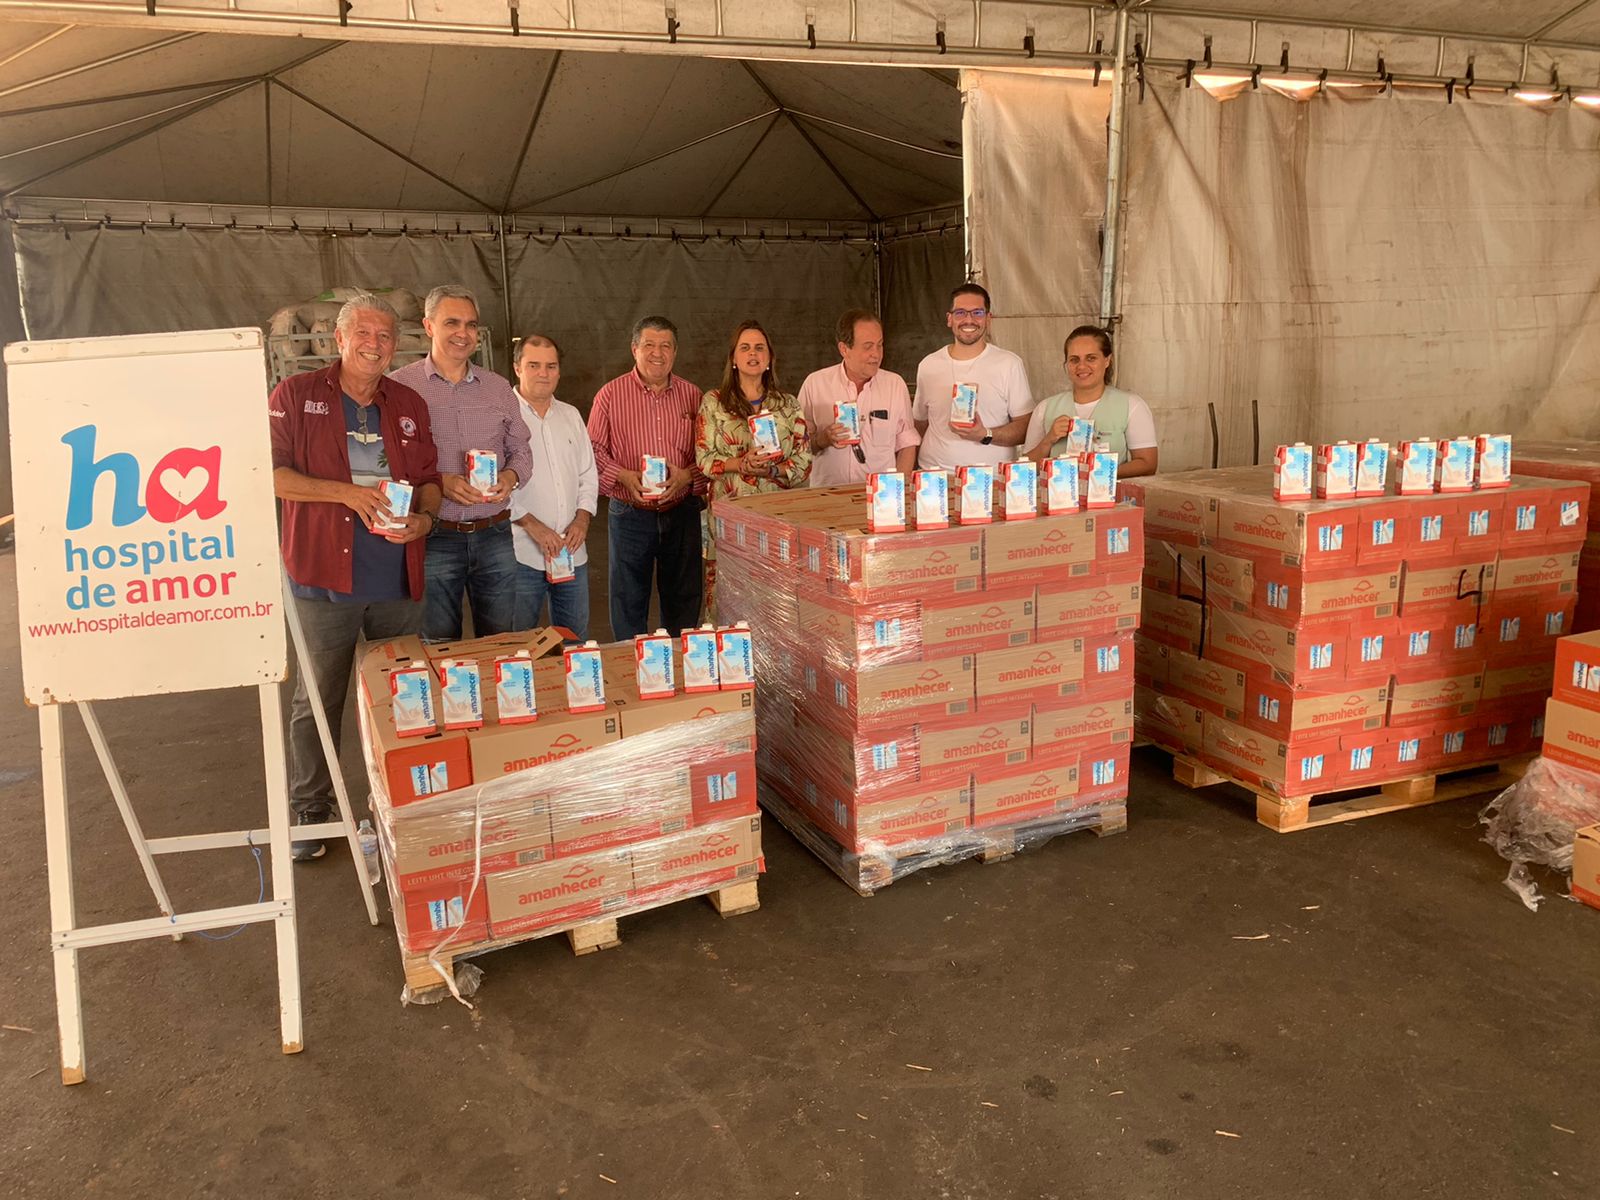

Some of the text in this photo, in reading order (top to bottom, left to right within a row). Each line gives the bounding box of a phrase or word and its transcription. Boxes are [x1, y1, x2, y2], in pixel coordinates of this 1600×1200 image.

[61, 424, 227, 530] ha
[1233, 521, 1287, 541] amanhecer
[64, 525, 235, 574] hospital
[1008, 542, 1074, 560] amanhecer
[1513, 569, 1564, 584] amanhecer
[66, 572, 237, 610] de amor
[1320, 592, 1380, 609] amanhecer
[28, 602, 273, 638] www.hospitaldeamor.com.br
[1059, 602, 1121, 622] amanhecer
[945, 619, 1014, 638] amanhecer
[663, 645, 672, 684] amanhecer
[706, 640, 715, 679] amanhecer
[742, 638, 751, 677] amanhecer
[591, 657, 600, 698] amanhecer
[998, 663, 1063, 682] amanhecer
[419, 678, 430, 720] amanhecer
[468, 672, 478, 714] amanhecer
[522, 667, 532, 709] amanhecer
[880, 681, 951, 701] amanhecer
[1312, 706, 1370, 724] amanhecer
[1054, 718, 1116, 739] amanhecer
[943, 737, 1011, 759] amanhecer
[997, 785, 1060, 808] amanhecer
[880, 807, 950, 831] amanhecer
[660, 843, 740, 872] amanhecer
[518, 875, 605, 905] amanhecer
